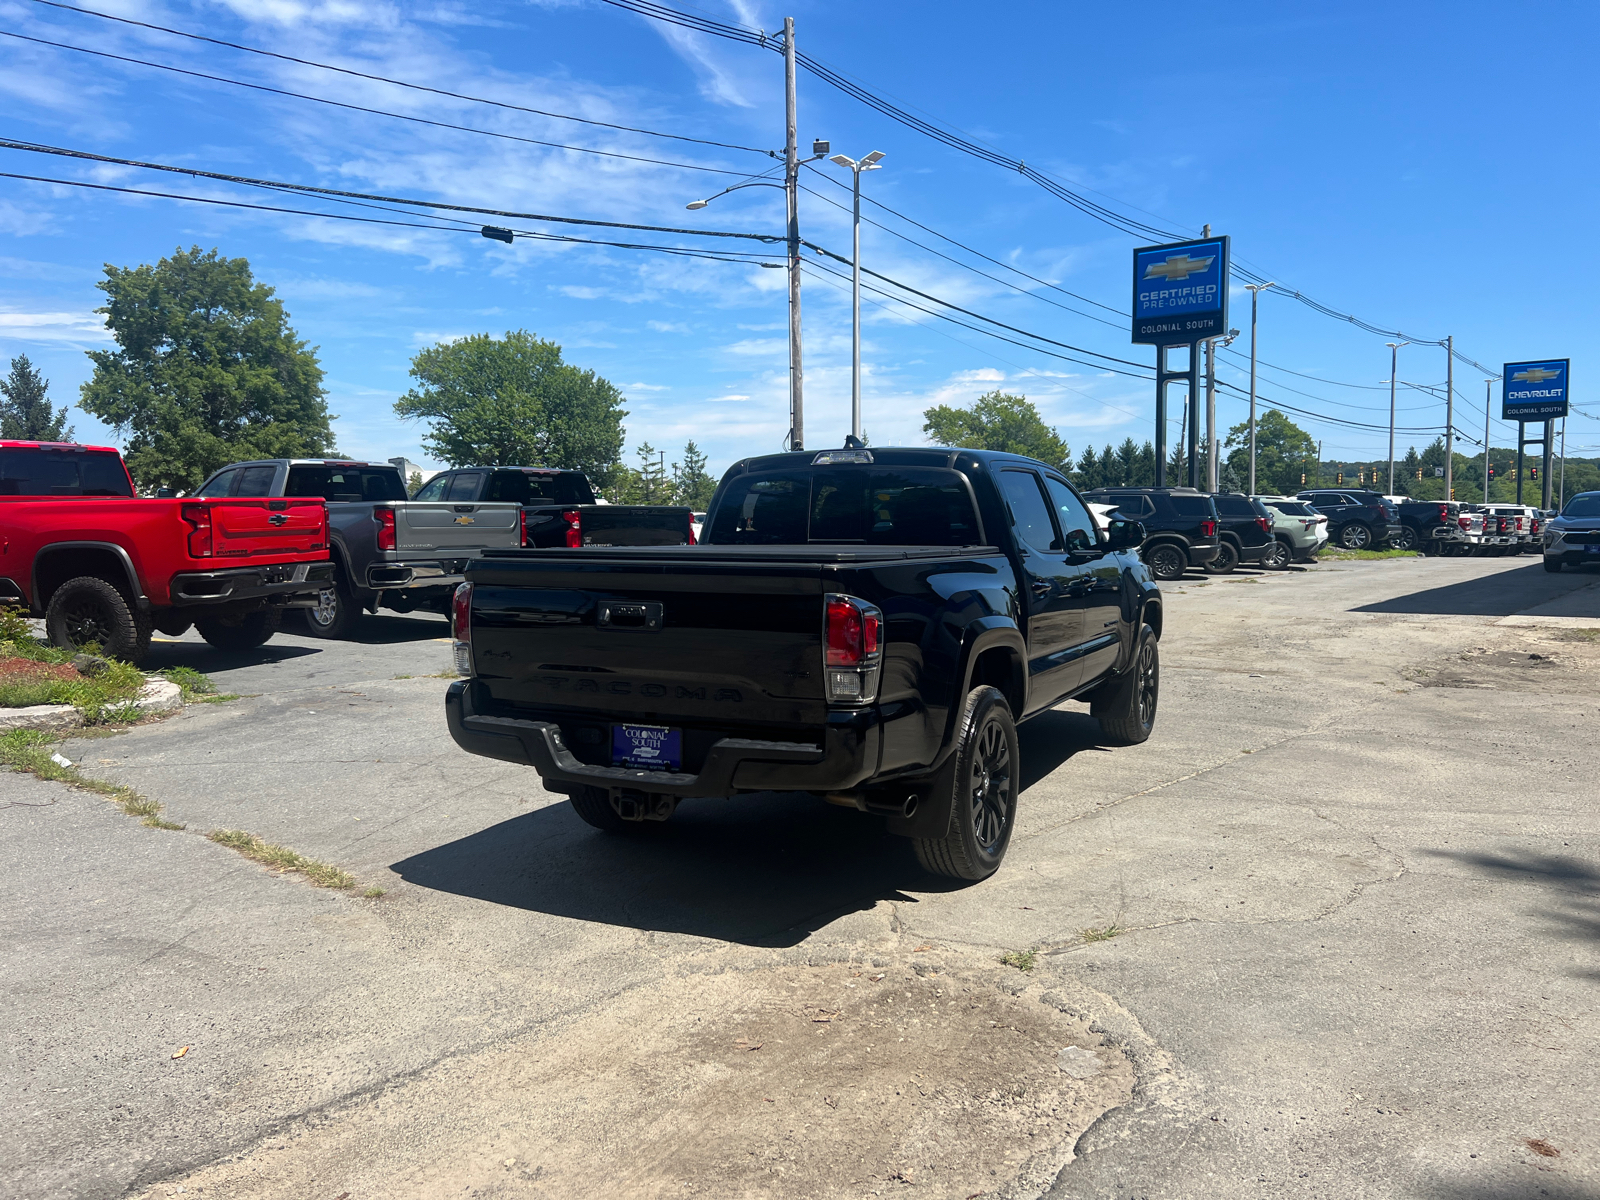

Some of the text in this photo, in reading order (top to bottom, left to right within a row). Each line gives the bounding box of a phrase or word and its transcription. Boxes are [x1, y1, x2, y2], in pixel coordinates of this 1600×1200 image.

[1140, 284, 1217, 301] CERTIFIED
[1143, 294, 1213, 310] PRE-OWNED
[1141, 319, 1214, 334] COLONIAL SOUTH
[1508, 388, 1563, 399] CHEVROLET
[541, 675, 744, 702] TACOMA
[625, 729, 668, 741] COLONIAL
[632, 738, 661, 748] SOUTH
